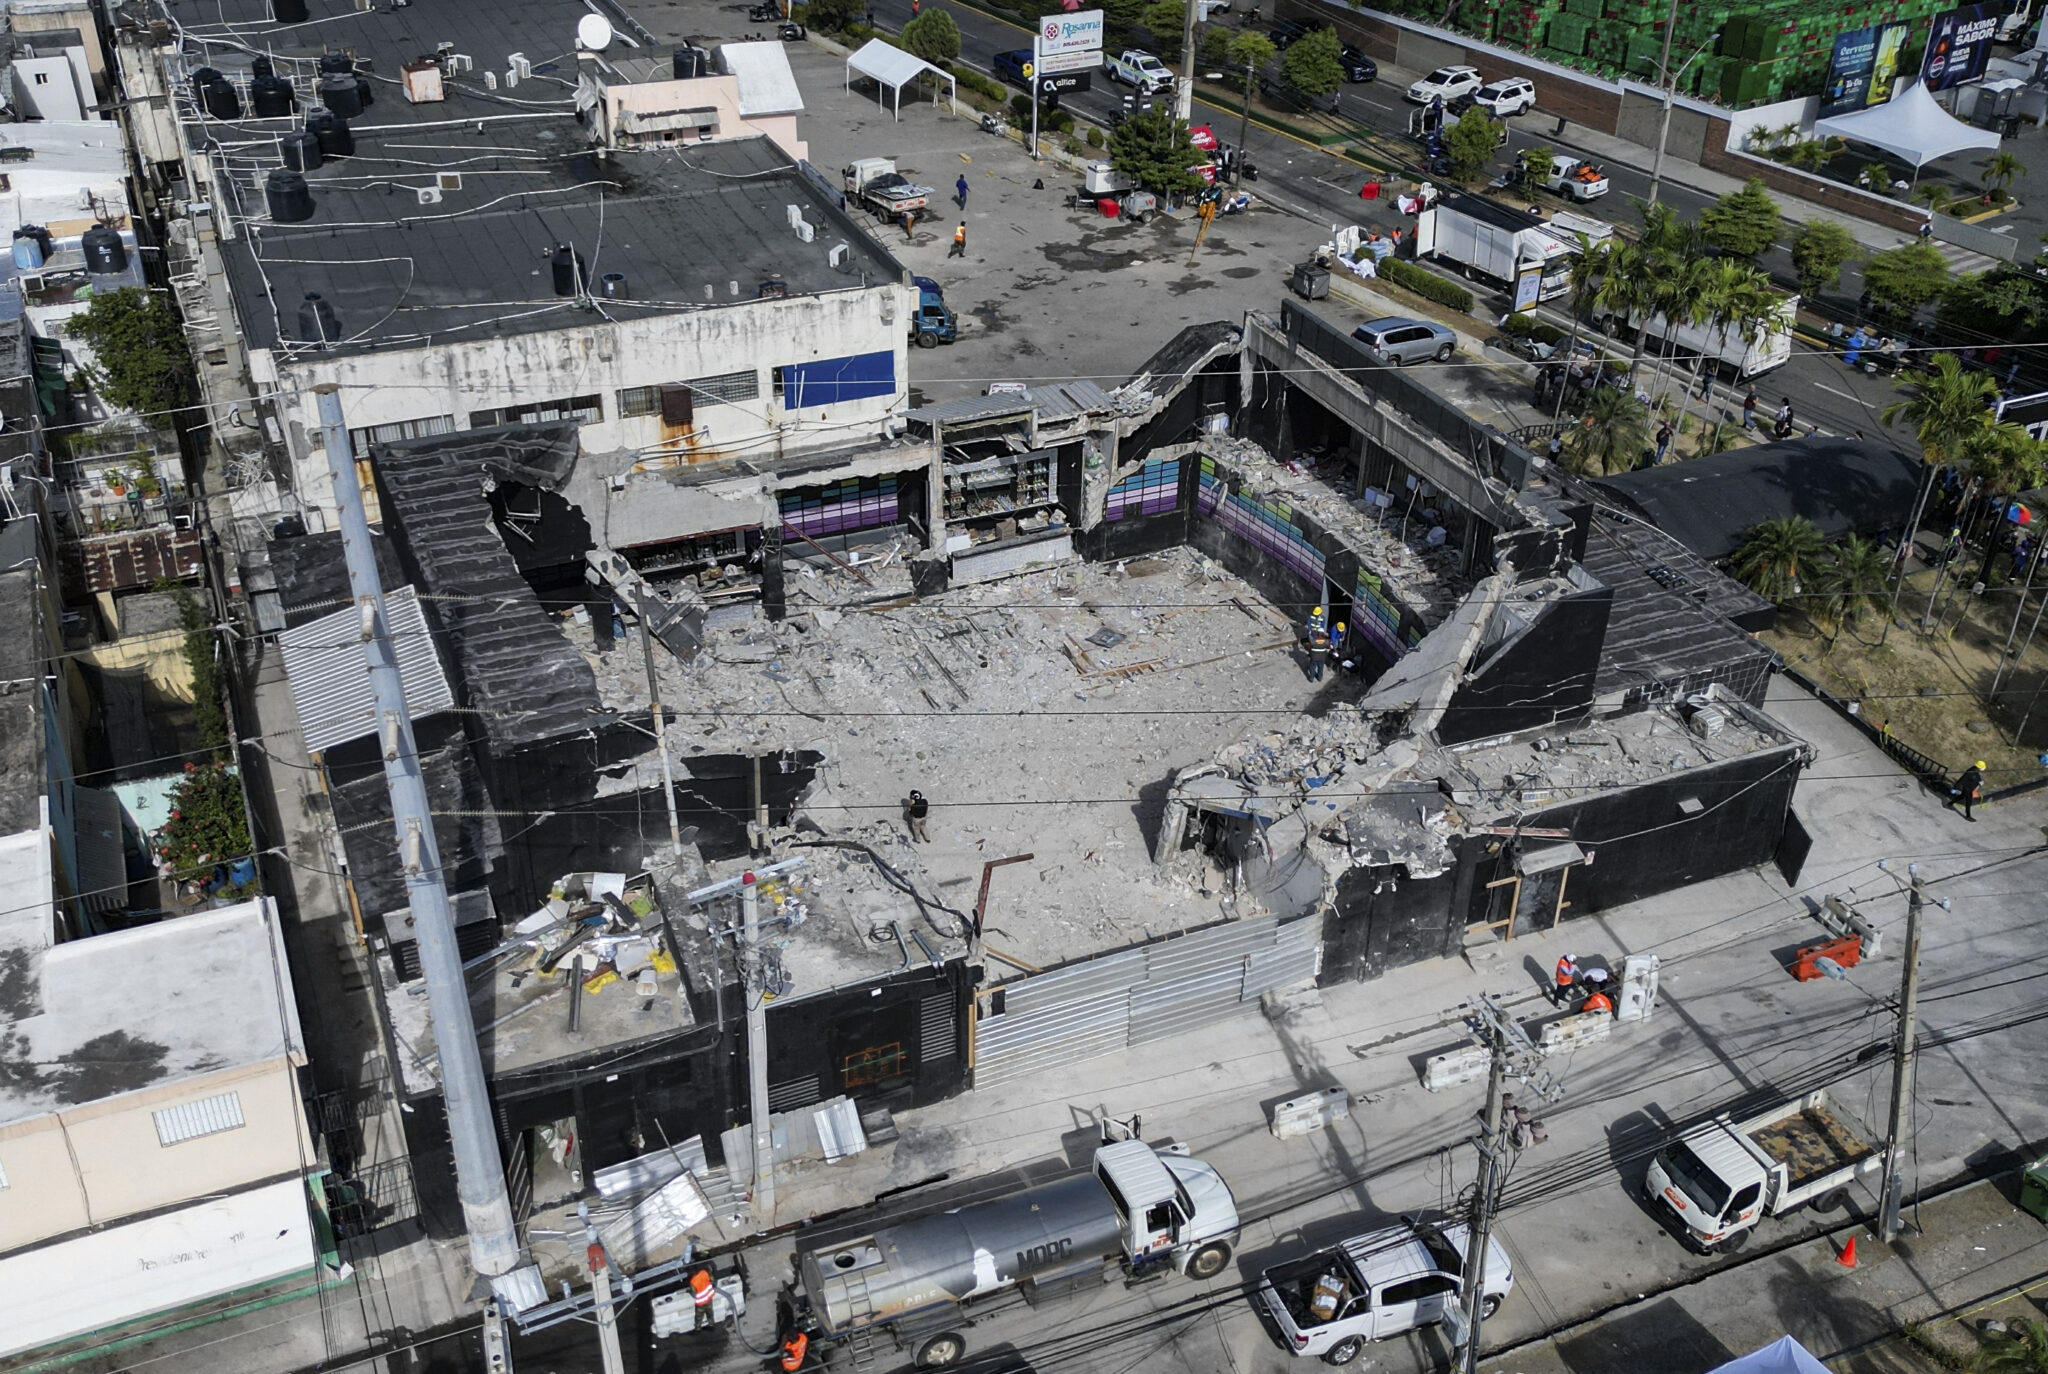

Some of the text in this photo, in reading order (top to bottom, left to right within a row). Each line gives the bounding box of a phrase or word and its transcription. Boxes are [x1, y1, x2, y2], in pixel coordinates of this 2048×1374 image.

[1061, 20, 1101, 39] Rosanna
[1957, 17, 1997, 35] MÁXIMO
[1955, 27, 1994, 46] SABOR
[1056, 78, 1077, 87] altice
[1544, 242, 1559, 252] JAC
[1016, 1237, 1073, 1274] MOPC
